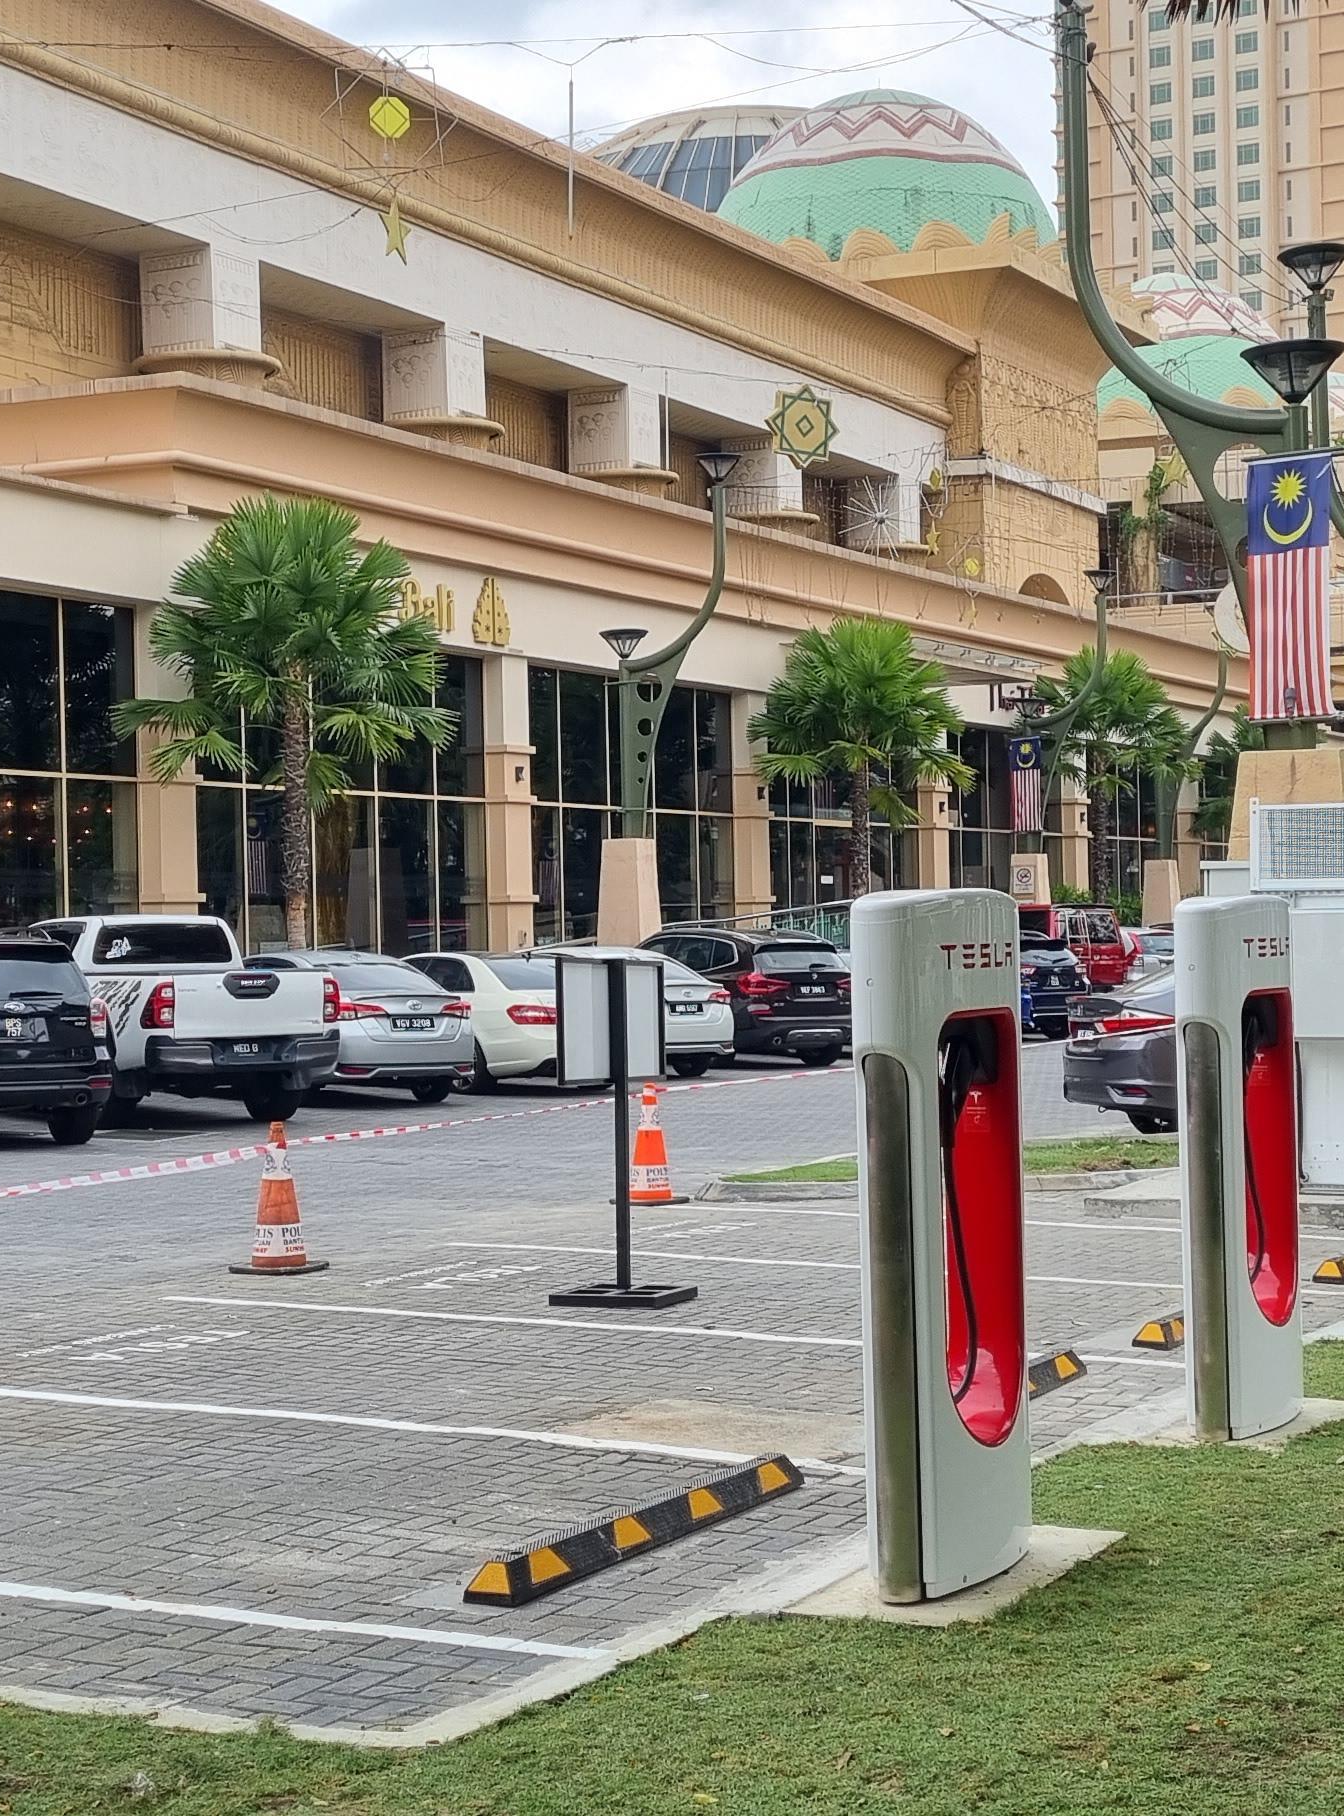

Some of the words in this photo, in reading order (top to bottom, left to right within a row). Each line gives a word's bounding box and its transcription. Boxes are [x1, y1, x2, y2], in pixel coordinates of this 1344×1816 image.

[397, 577, 455, 633] Bali
[940, 942, 1012, 970] TESLA
[68, 1330, 252, 1361] TESLA
